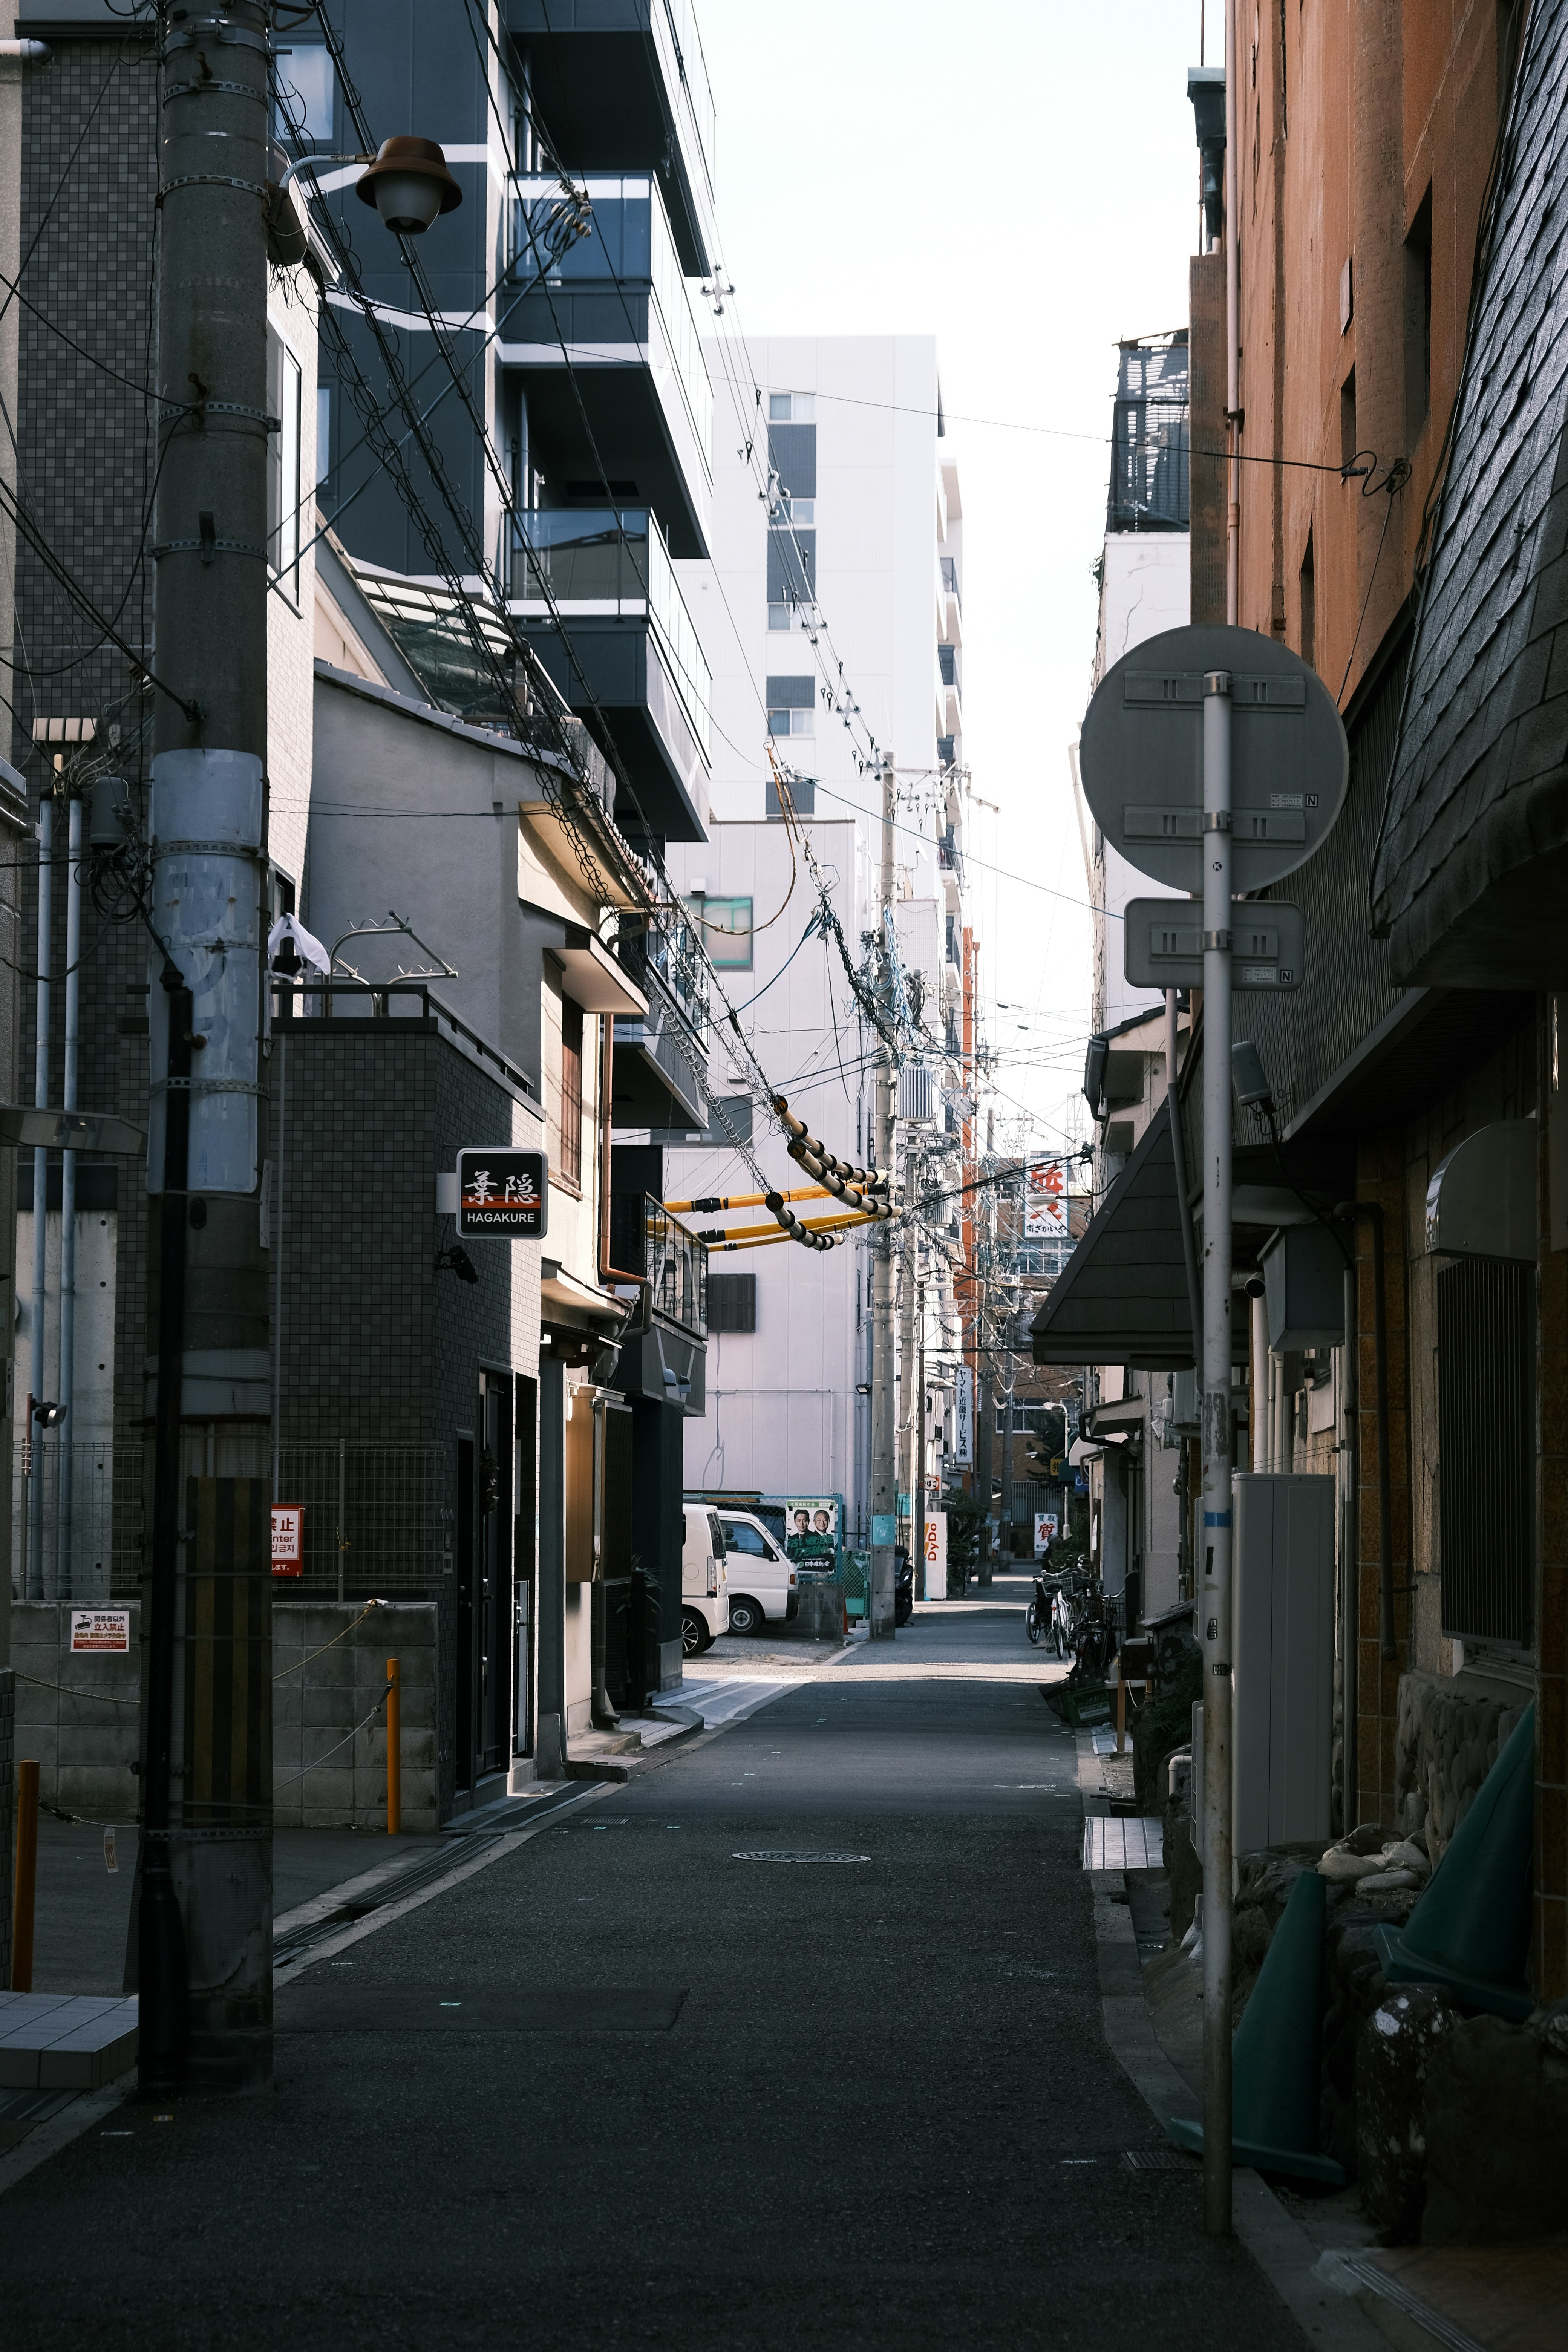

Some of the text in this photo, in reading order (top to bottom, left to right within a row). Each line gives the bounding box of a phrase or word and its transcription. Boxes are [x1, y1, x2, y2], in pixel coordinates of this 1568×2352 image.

[464, 1170, 539, 1206] 葉隠
[467, 1213, 535, 1223] HAGAKURE
[1026, 1224, 1066, 1234] 南さかいや
[1038, 1523, 1055, 1541] 質
[928, 1522, 939, 1561] DyDo
